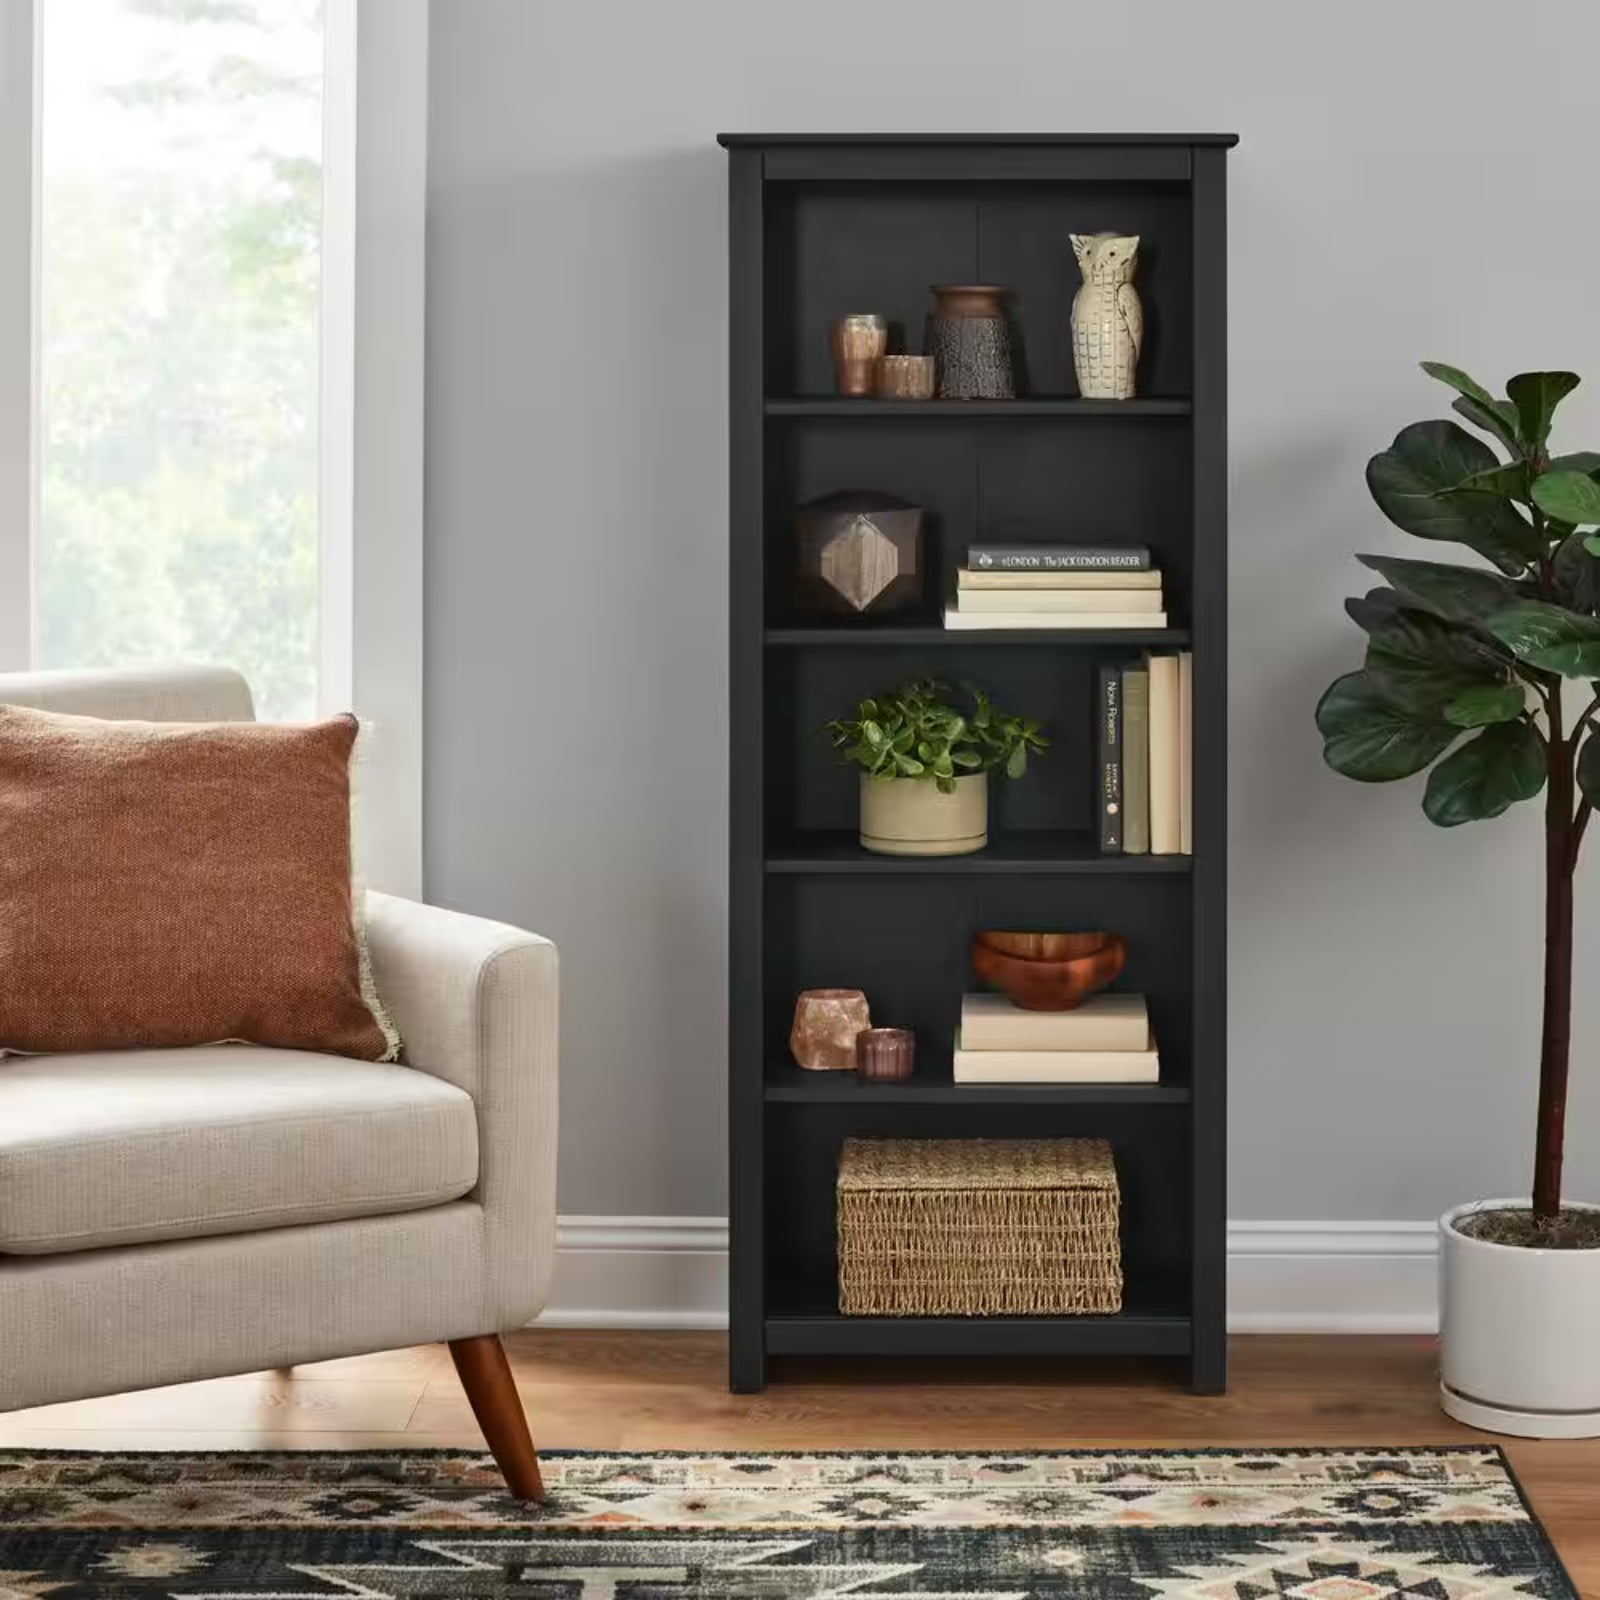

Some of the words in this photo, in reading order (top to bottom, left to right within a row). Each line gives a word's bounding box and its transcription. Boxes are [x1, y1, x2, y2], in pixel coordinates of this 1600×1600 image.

[1043, 555, 1056, 567] The
[1077, 555, 1110, 567] LONDON
[1111, 555, 1141, 567] READER
